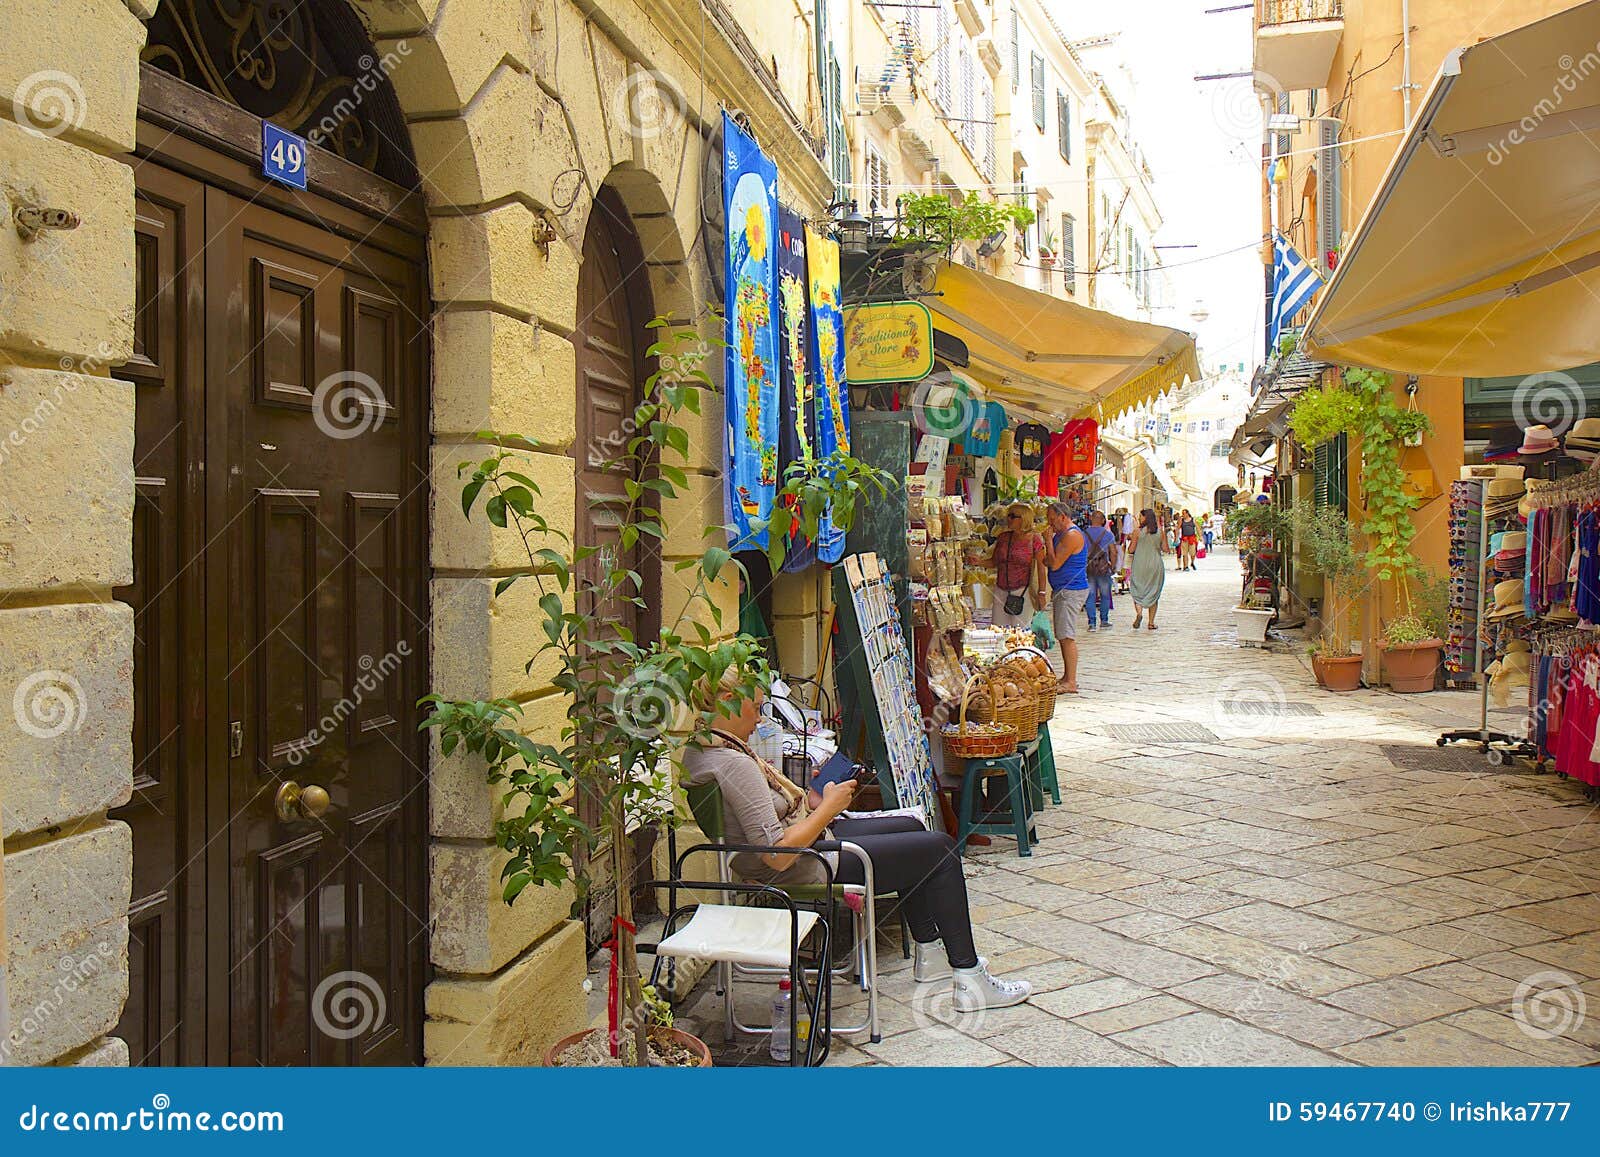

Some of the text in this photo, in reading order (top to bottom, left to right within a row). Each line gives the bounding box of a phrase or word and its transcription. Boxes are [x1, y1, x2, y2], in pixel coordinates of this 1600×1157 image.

[270, 140, 302, 173] 49
[856, 327, 914, 345] Traditional
[870, 342, 898, 356] Store
